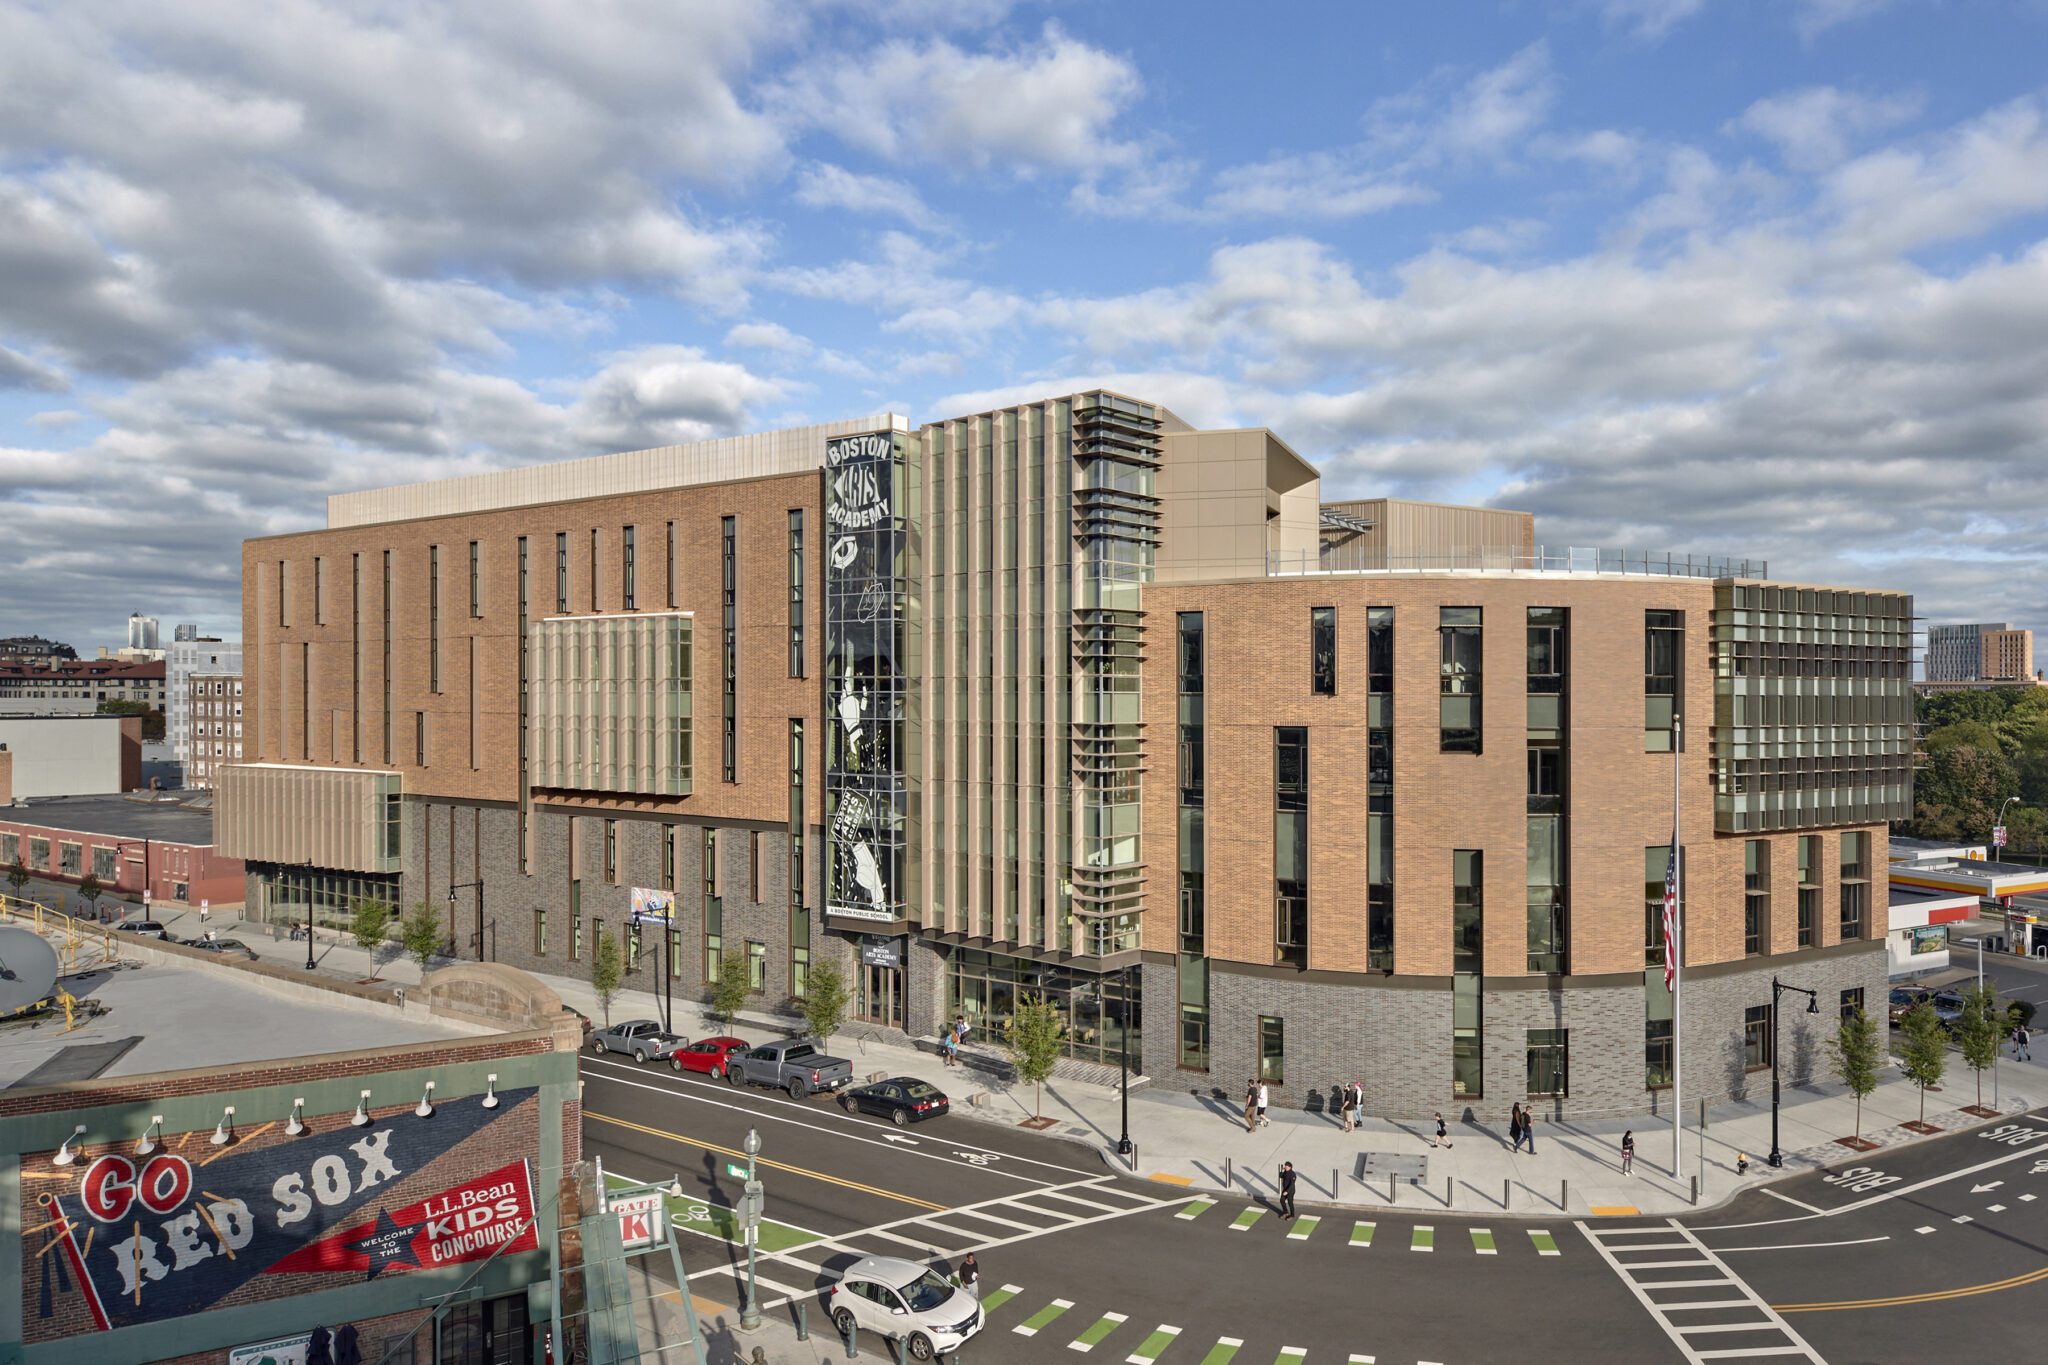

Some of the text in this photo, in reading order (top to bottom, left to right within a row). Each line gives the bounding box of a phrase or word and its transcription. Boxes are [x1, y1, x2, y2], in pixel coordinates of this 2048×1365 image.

[828, 437, 889, 465] BOSTON
[834, 464, 881, 508] ARTS
[828, 498, 889, 528] ACADEMY
[841, 797, 859, 836] ARTS
[1978, 1124, 2048, 1146] BUS
[81, 1154, 193, 1223] GO
[1823, 1167, 1902, 1192] BUS
[109, 1129, 402, 1297] RED SOX
[424, 1182, 515, 1217] L.L.Bean
[614, 1199, 657, 1212] GATE
[427, 1198, 519, 1240] KIDS
[622, 1213, 650, 1240] K
[361, 1227, 415, 1248] WELCOME
[381, 1241, 397, 1249] TO
[431, 1217, 525, 1262] CONCOURSE
[379, 1247, 402, 1258] THE
[290, 1337, 311, 1346] PAR
